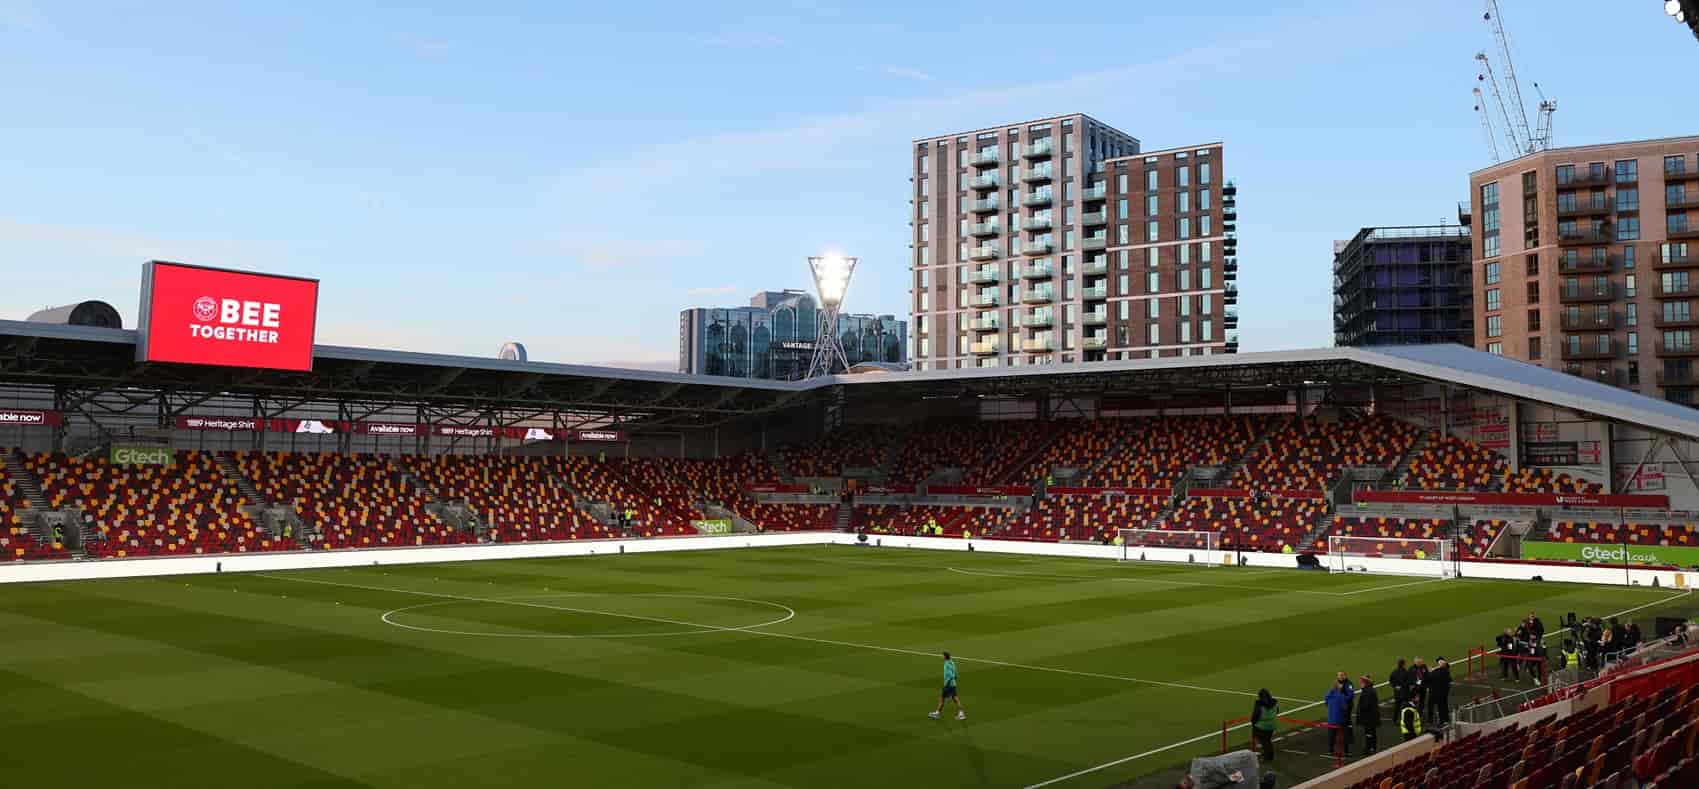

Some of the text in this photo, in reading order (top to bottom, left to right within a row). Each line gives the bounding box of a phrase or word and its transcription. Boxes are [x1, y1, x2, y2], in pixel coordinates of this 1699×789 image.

[220, 298, 281, 328] BEE
[189, 323, 279, 343] TOGETHER
[20, 414, 41, 422] now
[204, 419, 238, 430] Heritage
[369, 424, 399, 433] Available
[115, 448, 169, 465] Gtech
